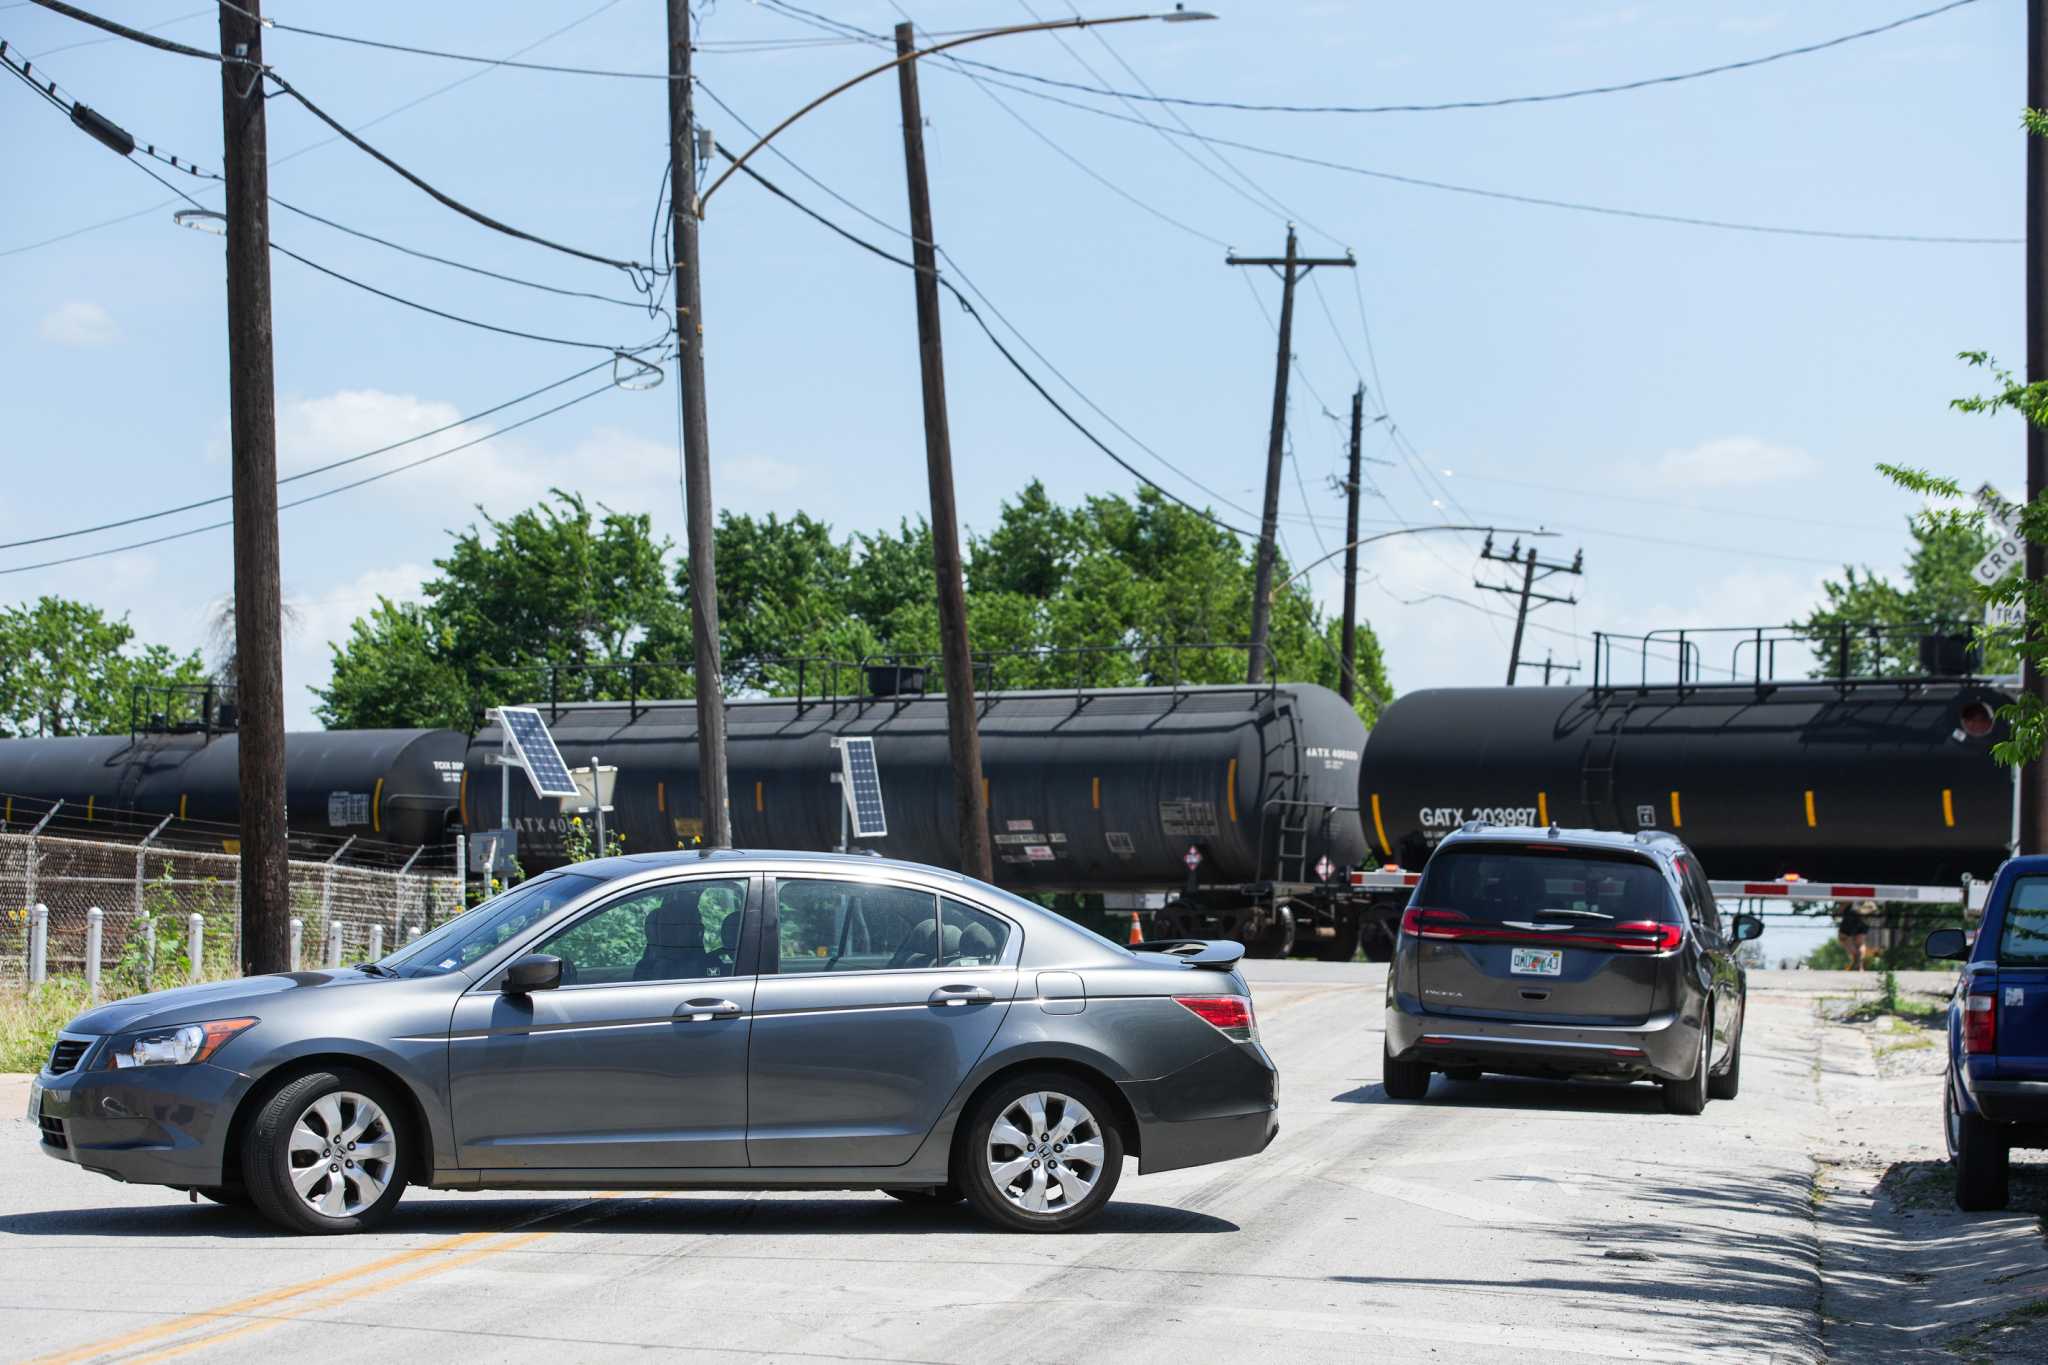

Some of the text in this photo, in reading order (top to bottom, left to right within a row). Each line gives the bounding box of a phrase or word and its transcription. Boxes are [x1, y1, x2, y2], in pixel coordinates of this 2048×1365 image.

[1979, 526, 2027, 580] CROS
[1996, 608, 2022, 623] TRA
[513, 817, 546, 833] ATX
[1419, 807, 1537, 827] GATX 203997
